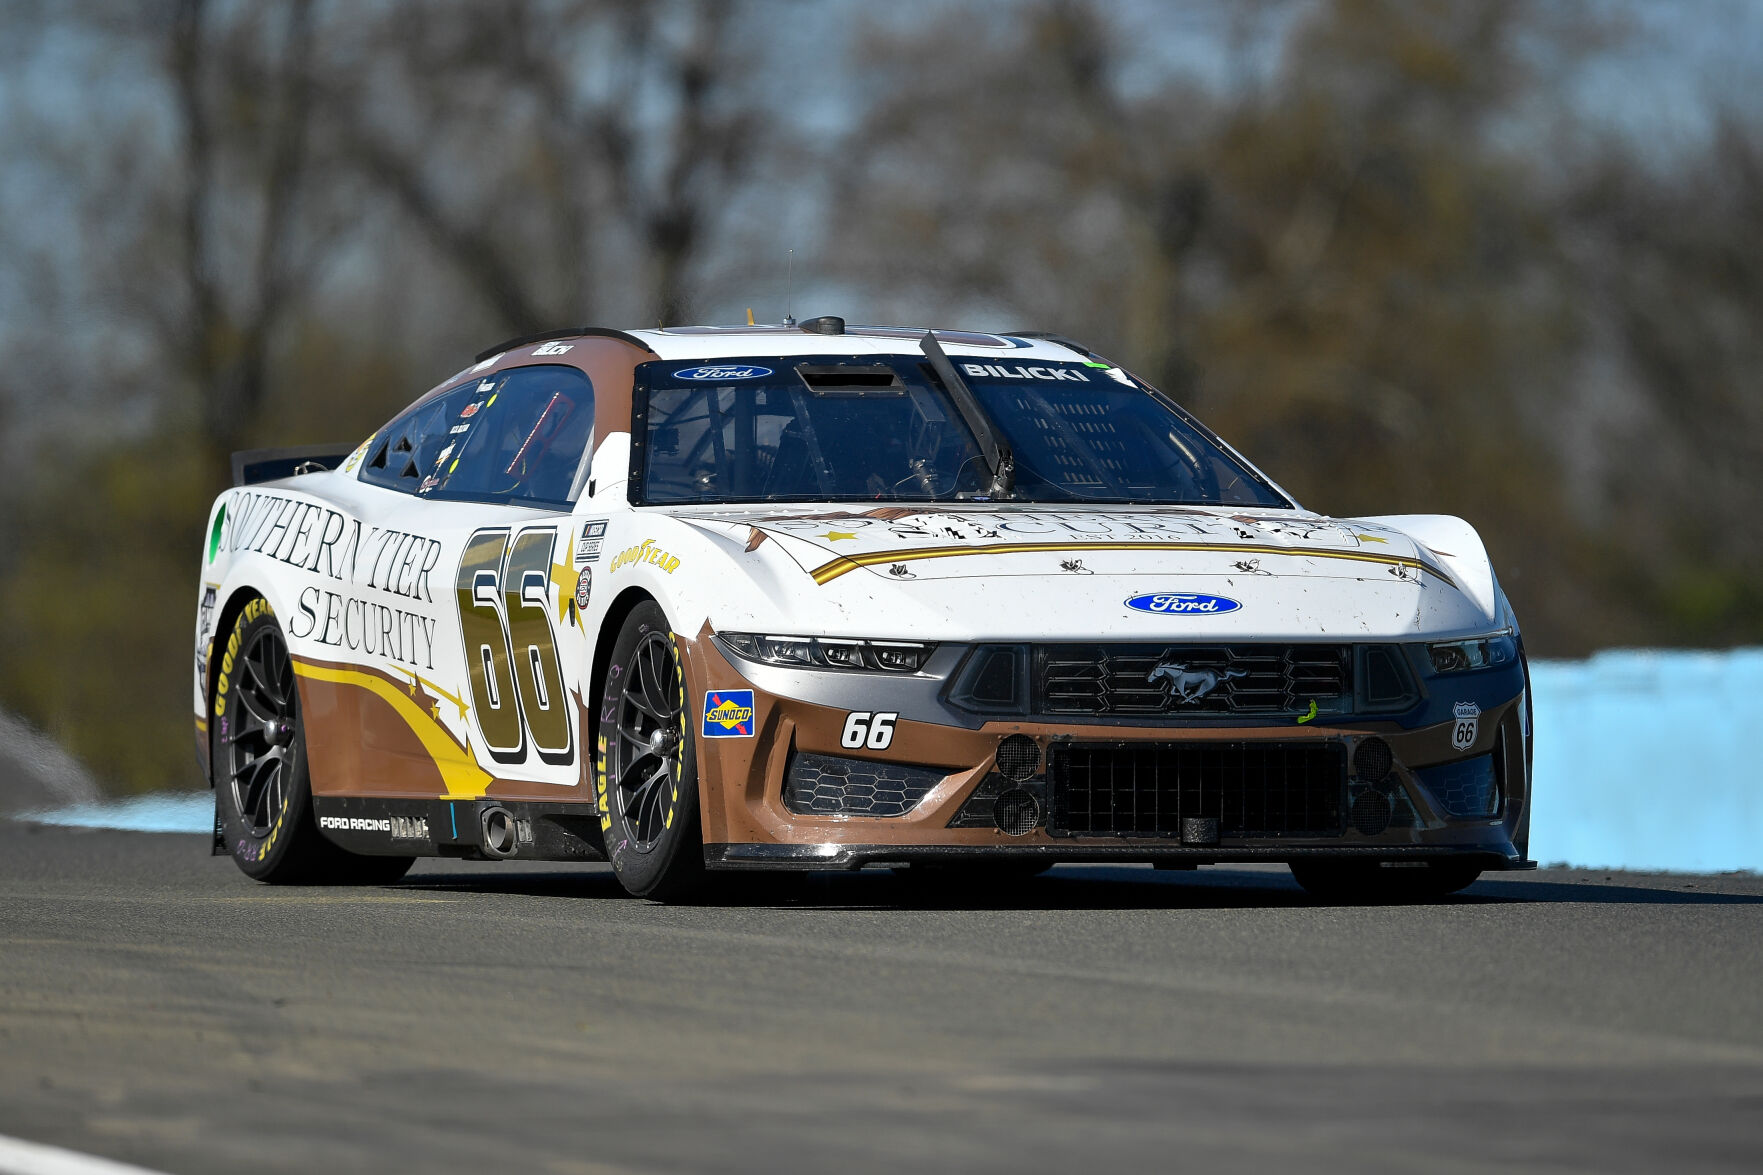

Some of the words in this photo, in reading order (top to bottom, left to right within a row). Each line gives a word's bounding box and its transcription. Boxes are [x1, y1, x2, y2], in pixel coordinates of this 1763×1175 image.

[693, 366, 753, 378] Ford
[961, 363, 1090, 382] BILICKI
[218, 490, 379, 584] SOUTHERN
[368, 529, 442, 603] TIER
[610, 539, 681, 574] GOODYEAR
[1149, 595, 1218, 611] Ford
[289, 586, 436, 670] SECURITY
[454, 525, 575, 766] 66
[707, 707, 752, 723] SUNOCO
[1457, 708, 1477, 716] GARAGE
[841, 711, 898, 750] 66
[1457, 722, 1474, 743] 66
[597, 735, 612, 832] EAGLE
[320, 816, 349, 829] FORD
[350, 818, 390, 831] RACING
